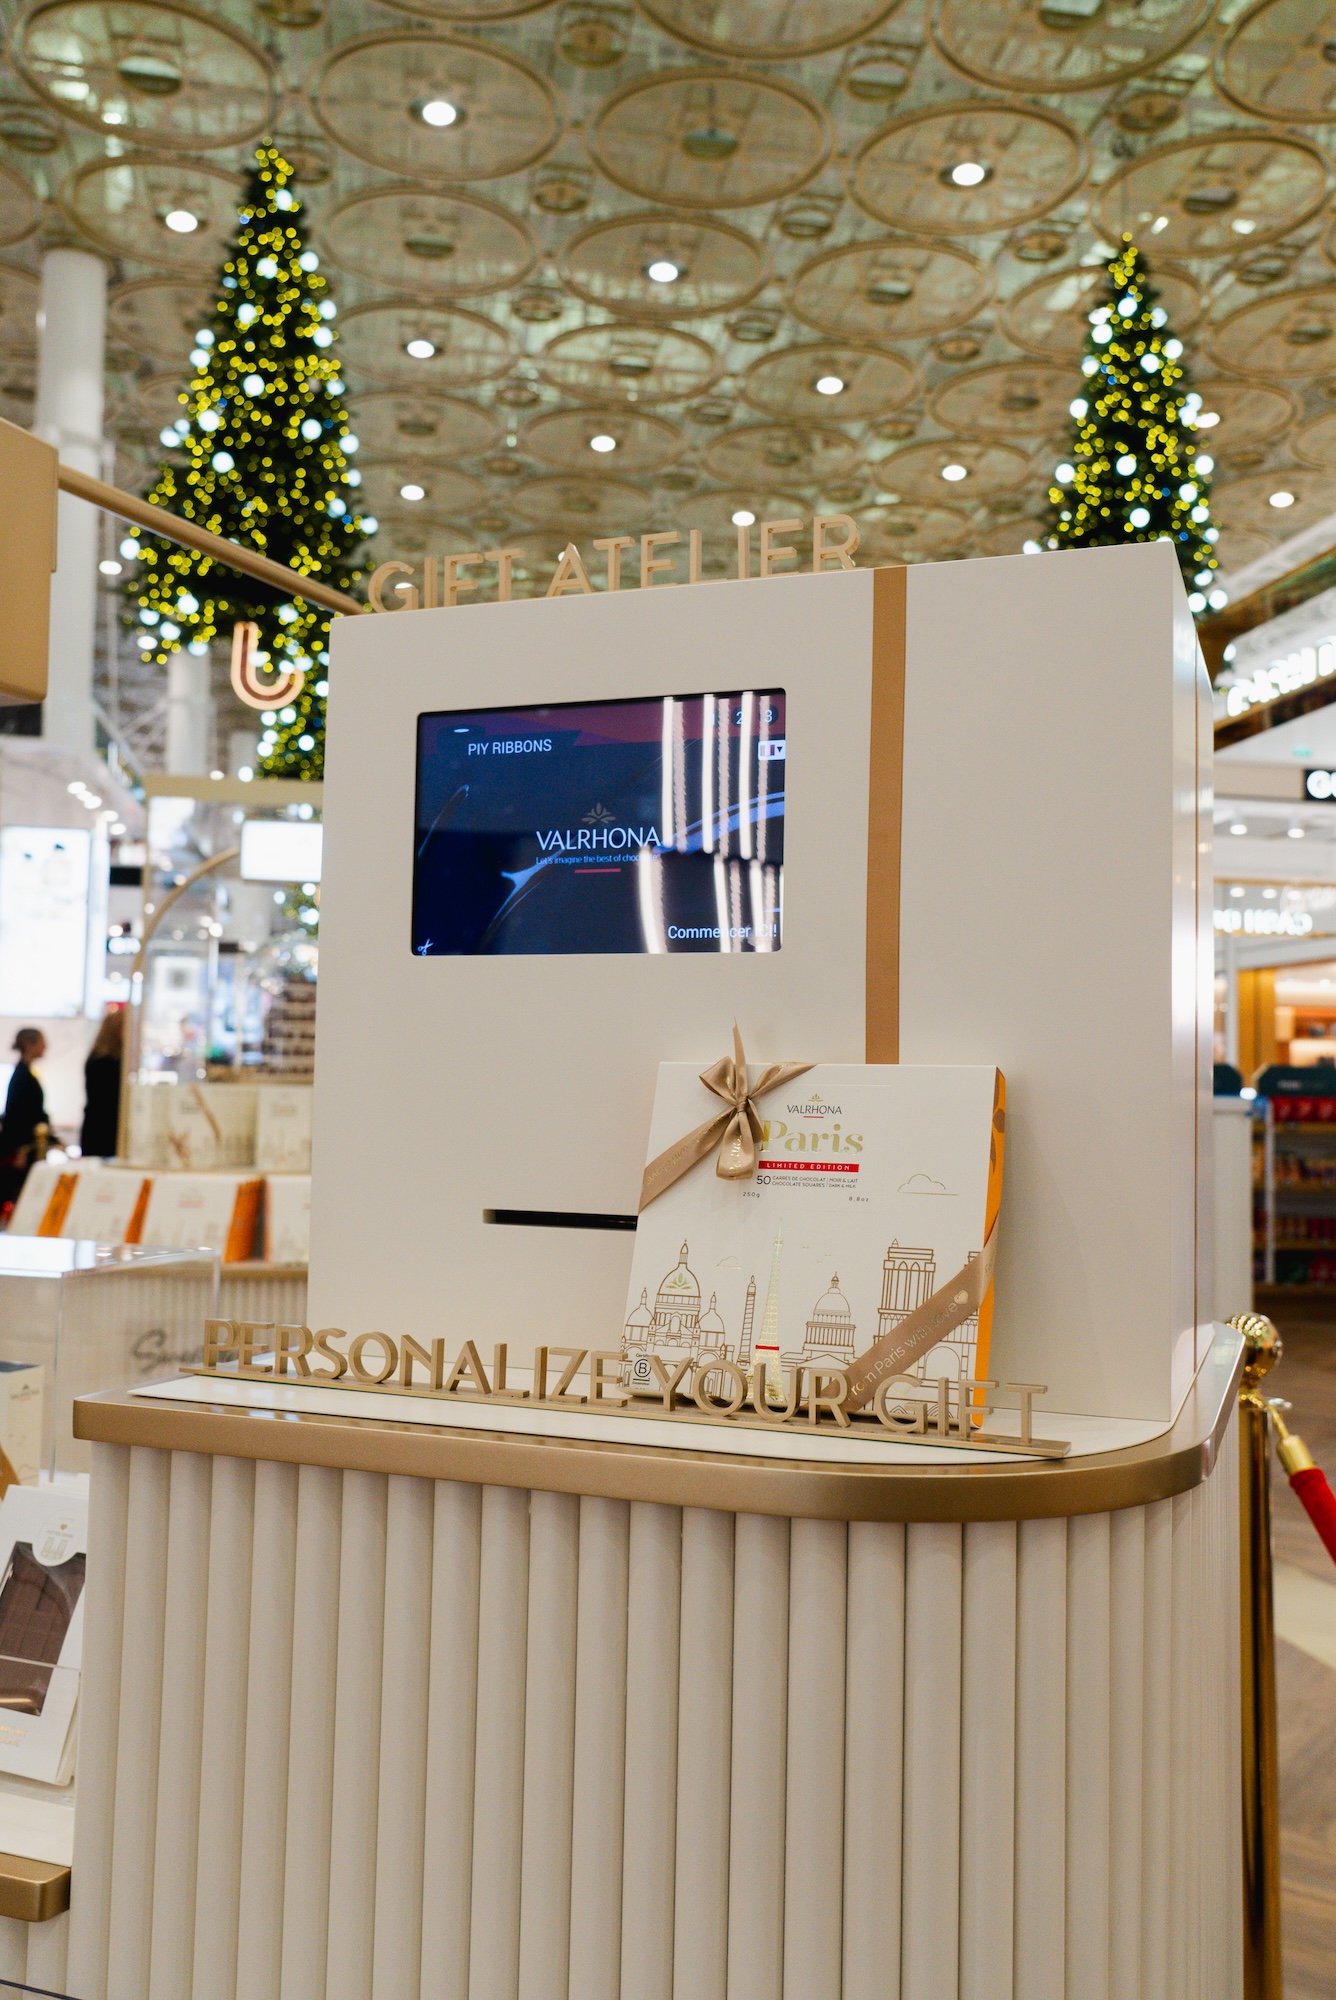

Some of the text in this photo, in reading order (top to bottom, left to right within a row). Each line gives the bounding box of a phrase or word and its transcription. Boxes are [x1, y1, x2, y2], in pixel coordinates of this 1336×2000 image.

[367, 513, 861, 614] GIFT ATELIER
[736, 711, 744, 725] 2
[764, 709, 773, 723] 3
[467, 739, 553, 756] PIY RIBBONS
[536, 826, 661, 851] VALRHONA
[583, 855, 595, 863] the
[596, 854, 613, 863] best
[613, 853, 621, 862] of
[786, 1104, 843, 1115] VALRHONA
[760, 1119, 864, 1156] Paris
[810, 1163, 850, 1171] EDITION
[756, 1175, 771, 1185] 50
[873, 1345, 906, 1375] Paris
[638, 1362, 648, 1374] B
[203, 1318, 628, 1408] PERSONALIZE
[650, 1354, 852, 1429] YOUR
[874, 1374, 1048, 1445] GIFT
